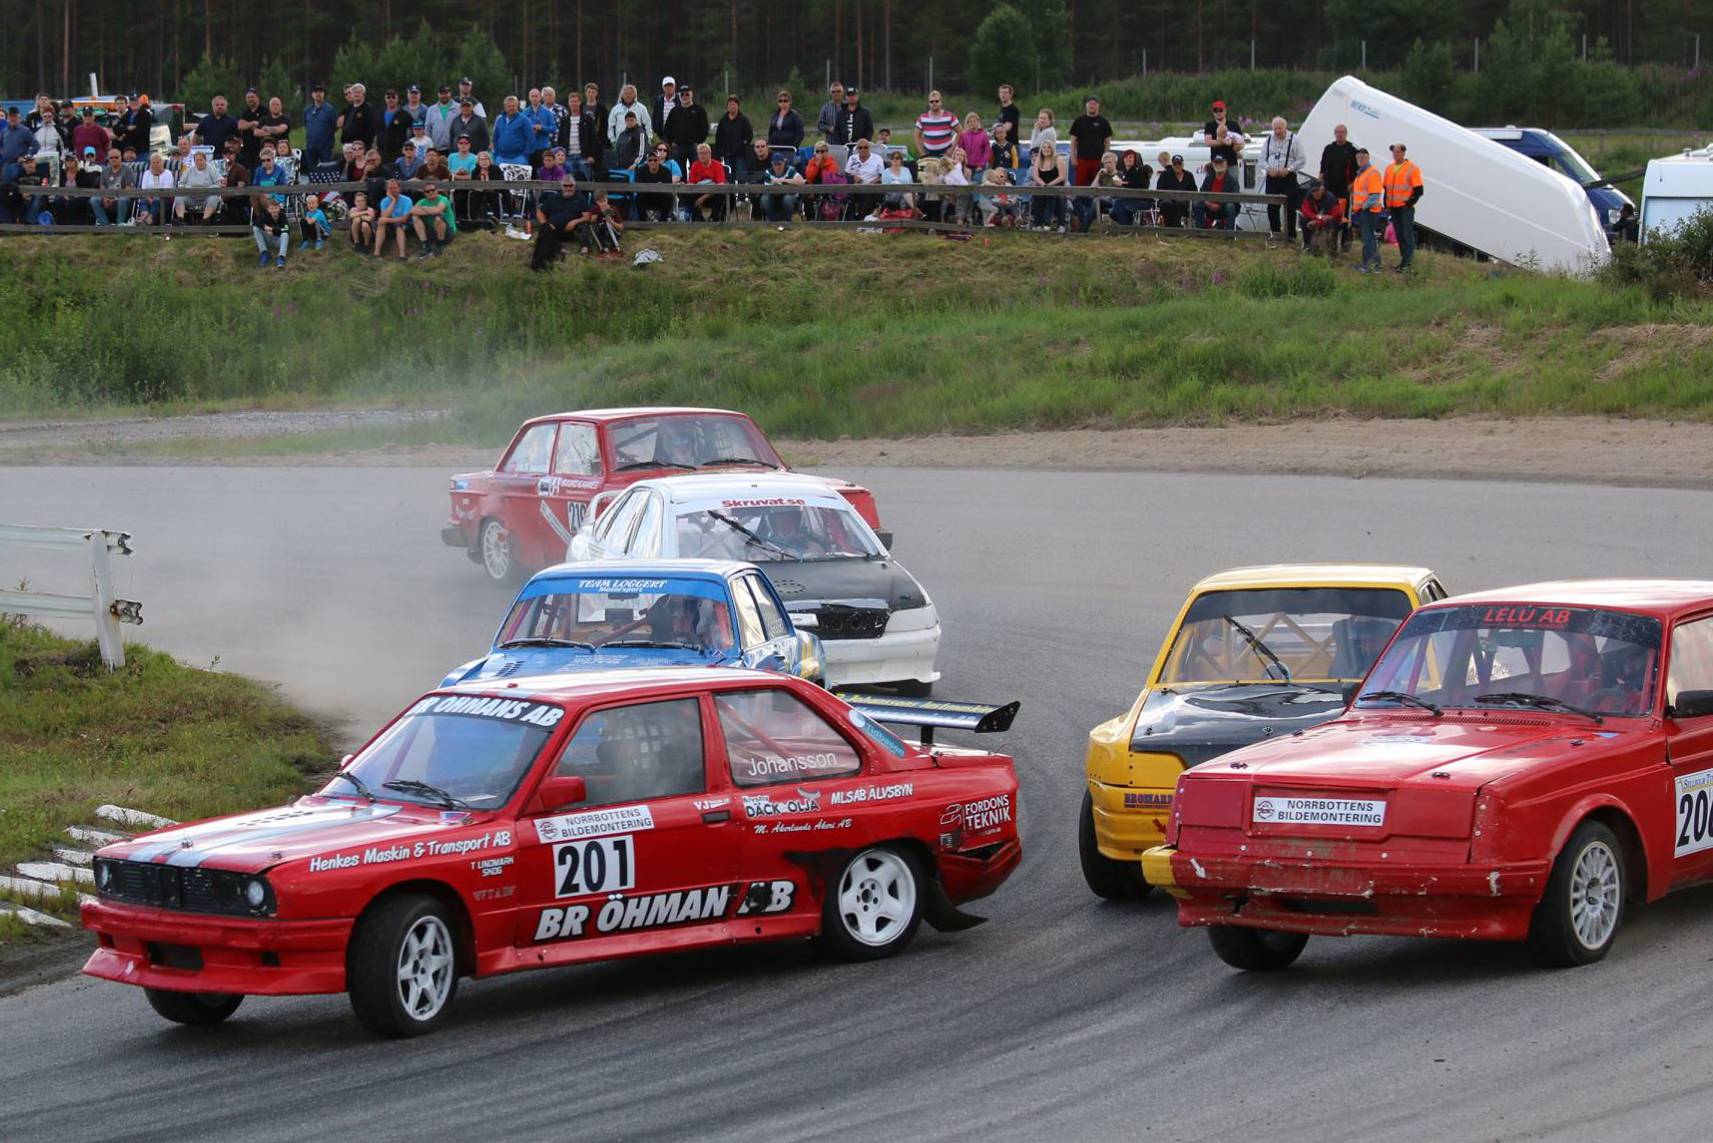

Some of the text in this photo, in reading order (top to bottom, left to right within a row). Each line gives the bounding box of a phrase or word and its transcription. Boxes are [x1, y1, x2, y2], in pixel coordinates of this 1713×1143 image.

[721, 498, 806, 508] Skruvat.se
[579, 579, 668, 588] TEAM LOGGERT
[1484, 608, 1572, 623] LELU AB
[520, 705, 565, 727] AB
[748, 753, 838, 776] Johansson
[831, 783, 914, 804] MLSAB ÄLVSBYN
[747, 799, 820, 818] DÄCK OLJA
[965, 794, 1009, 815] FORDONS
[1287, 800, 1374, 812] NORRBOTTENS
[565, 808, 641, 826] NORRBOTTENS
[966, 806, 1011, 829] TEKNIK
[1277, 812, 1382, 824] BILDEMONTERING
[561, 818, 652, 838] BILDEMONTERING
[309, 831, 512, 873] Henkes Maskin & Transport AB
[557, 839, 628, 896] 201
[534, 904, 590, 941] BR
[597, 886, 729, 932] ÖHMAN
